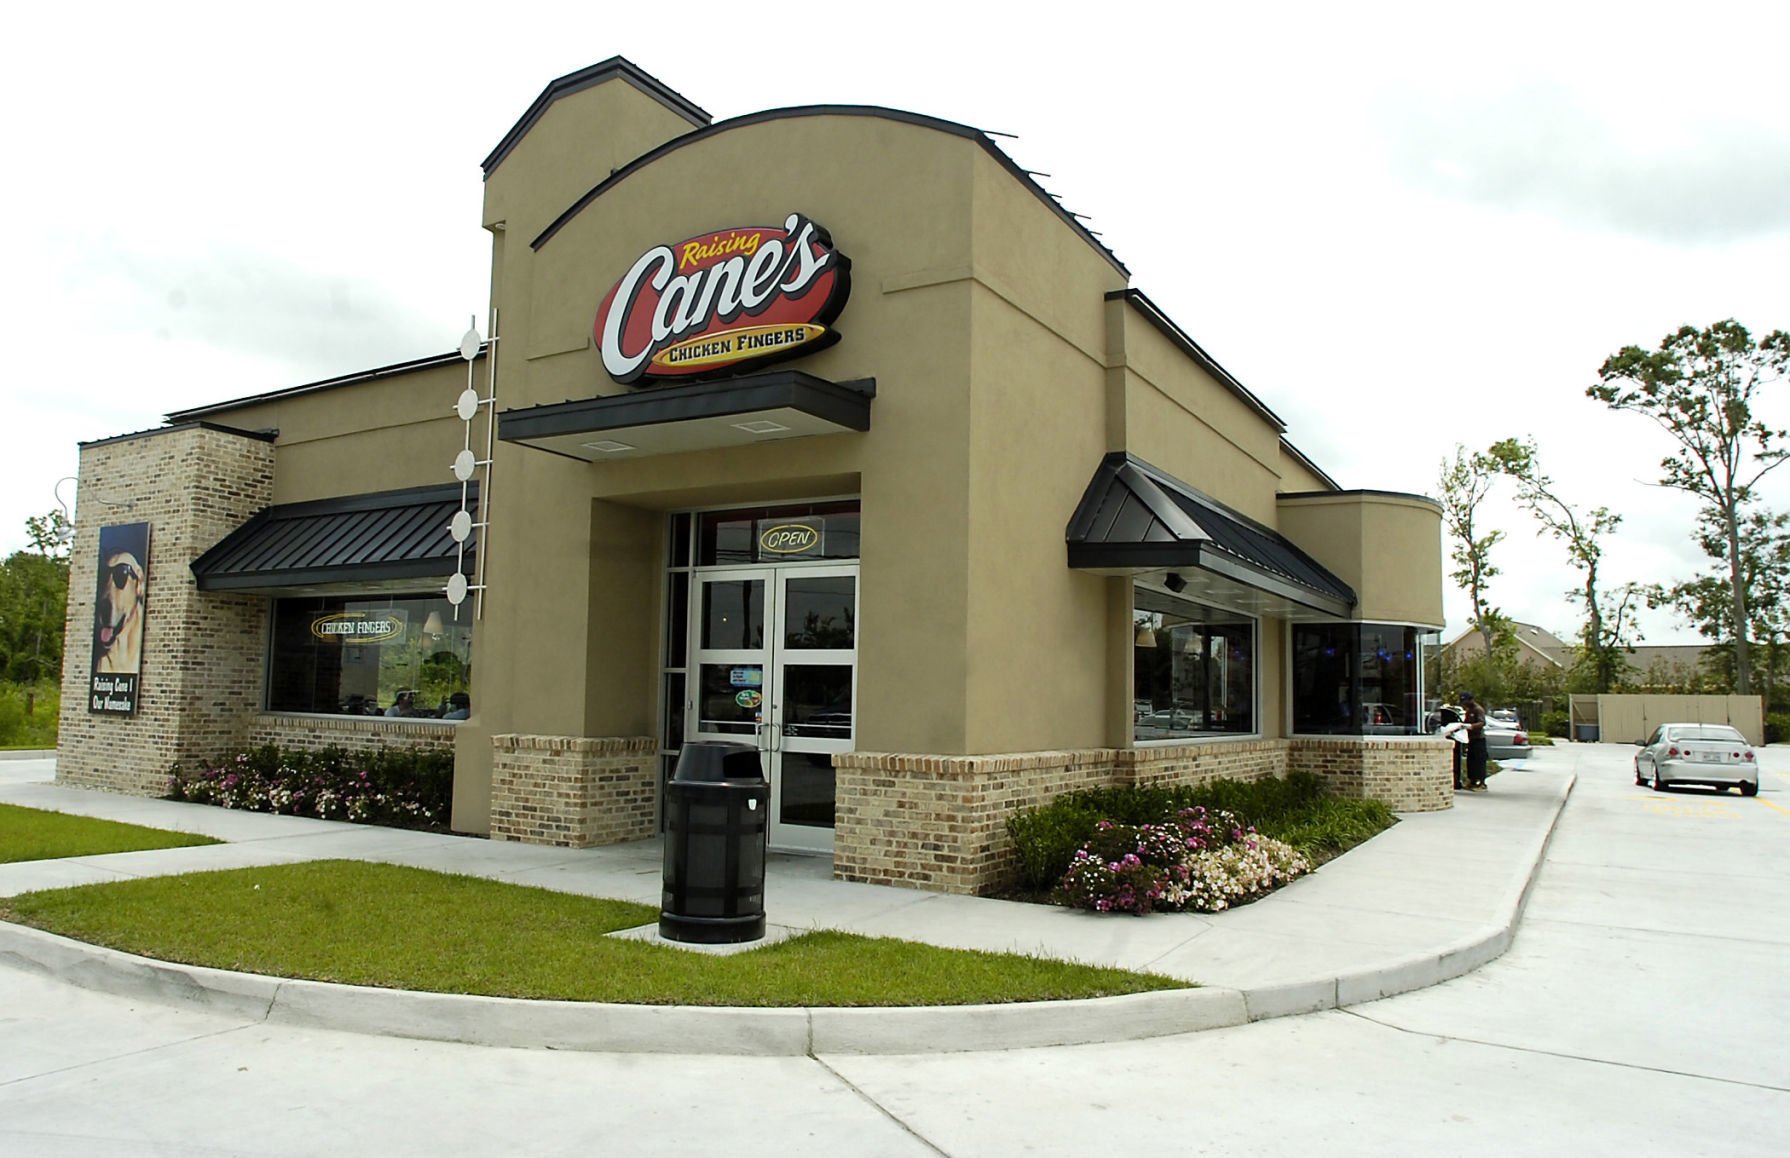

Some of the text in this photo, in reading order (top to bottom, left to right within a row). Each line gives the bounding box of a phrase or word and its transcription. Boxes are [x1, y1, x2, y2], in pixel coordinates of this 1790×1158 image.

[680, 232, 761, 269] Raising
[602, 213, 830, 376] Cane's
[669, 327, 805, 363] CHICKEN FINGERS
[768, 531, 811, 548] OPEN
[321, 621, 391, 635] CHICKEN FINGERS
[94, 676, 114, 696] Raising
[93, 695, 104, 710] Our
